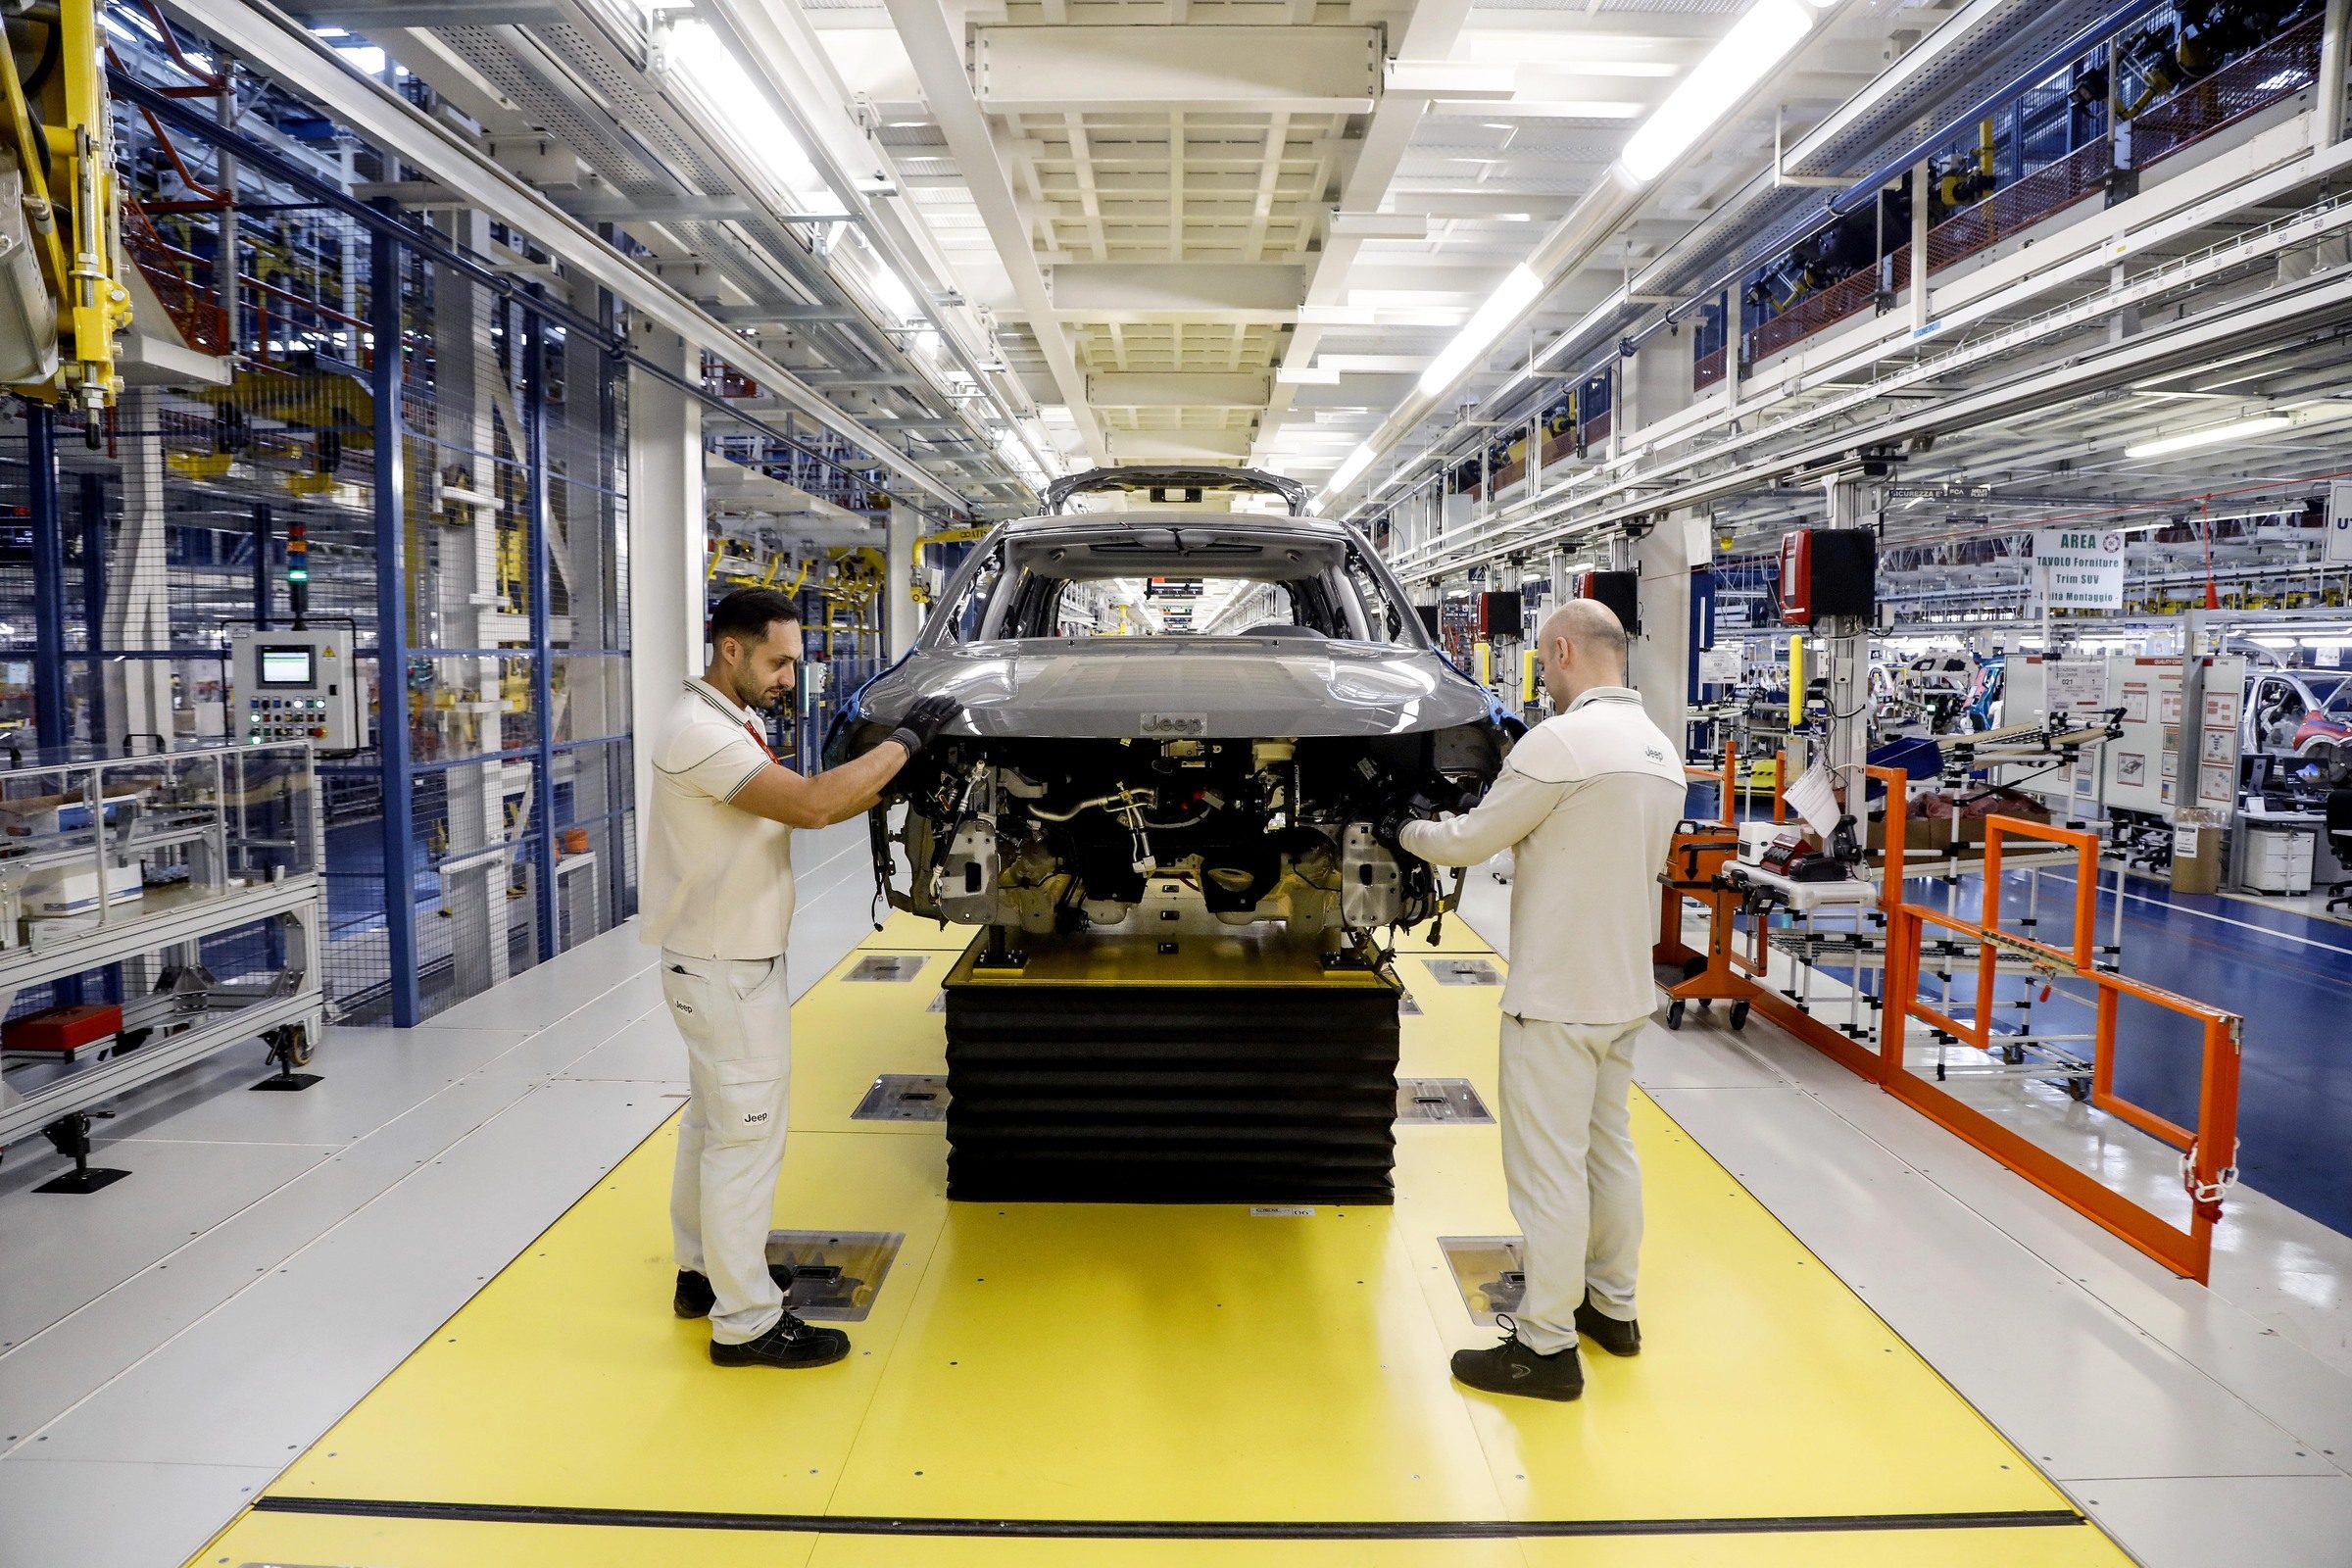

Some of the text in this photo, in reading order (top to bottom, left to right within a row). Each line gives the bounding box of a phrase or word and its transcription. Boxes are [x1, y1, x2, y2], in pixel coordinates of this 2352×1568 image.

[2184, 269, 2192, 277] 20
[2214, 258, 2222, 267] 30
[2245, 246, 2253, 255] 40
[2278, 232, 2287, 243] 50
[2314, 219, 2324, 229] 60
[2337, 517, 2352, 529] U
[2061, 534, 2096, 549] AREA
[2037, 557, 2119, 567] TAVOLO Forniture
[2056, 574, 2099, 584] Trim SUV
[2040, 591, 2113, 603] ità Montaggio
[1142, 714, 1202, 734] Jeep
[1644, 745, 1663, 762] Jeep
[674, 1001, 693, 1014] Jeep
[744, 1111, 768, 1124] Jeep
